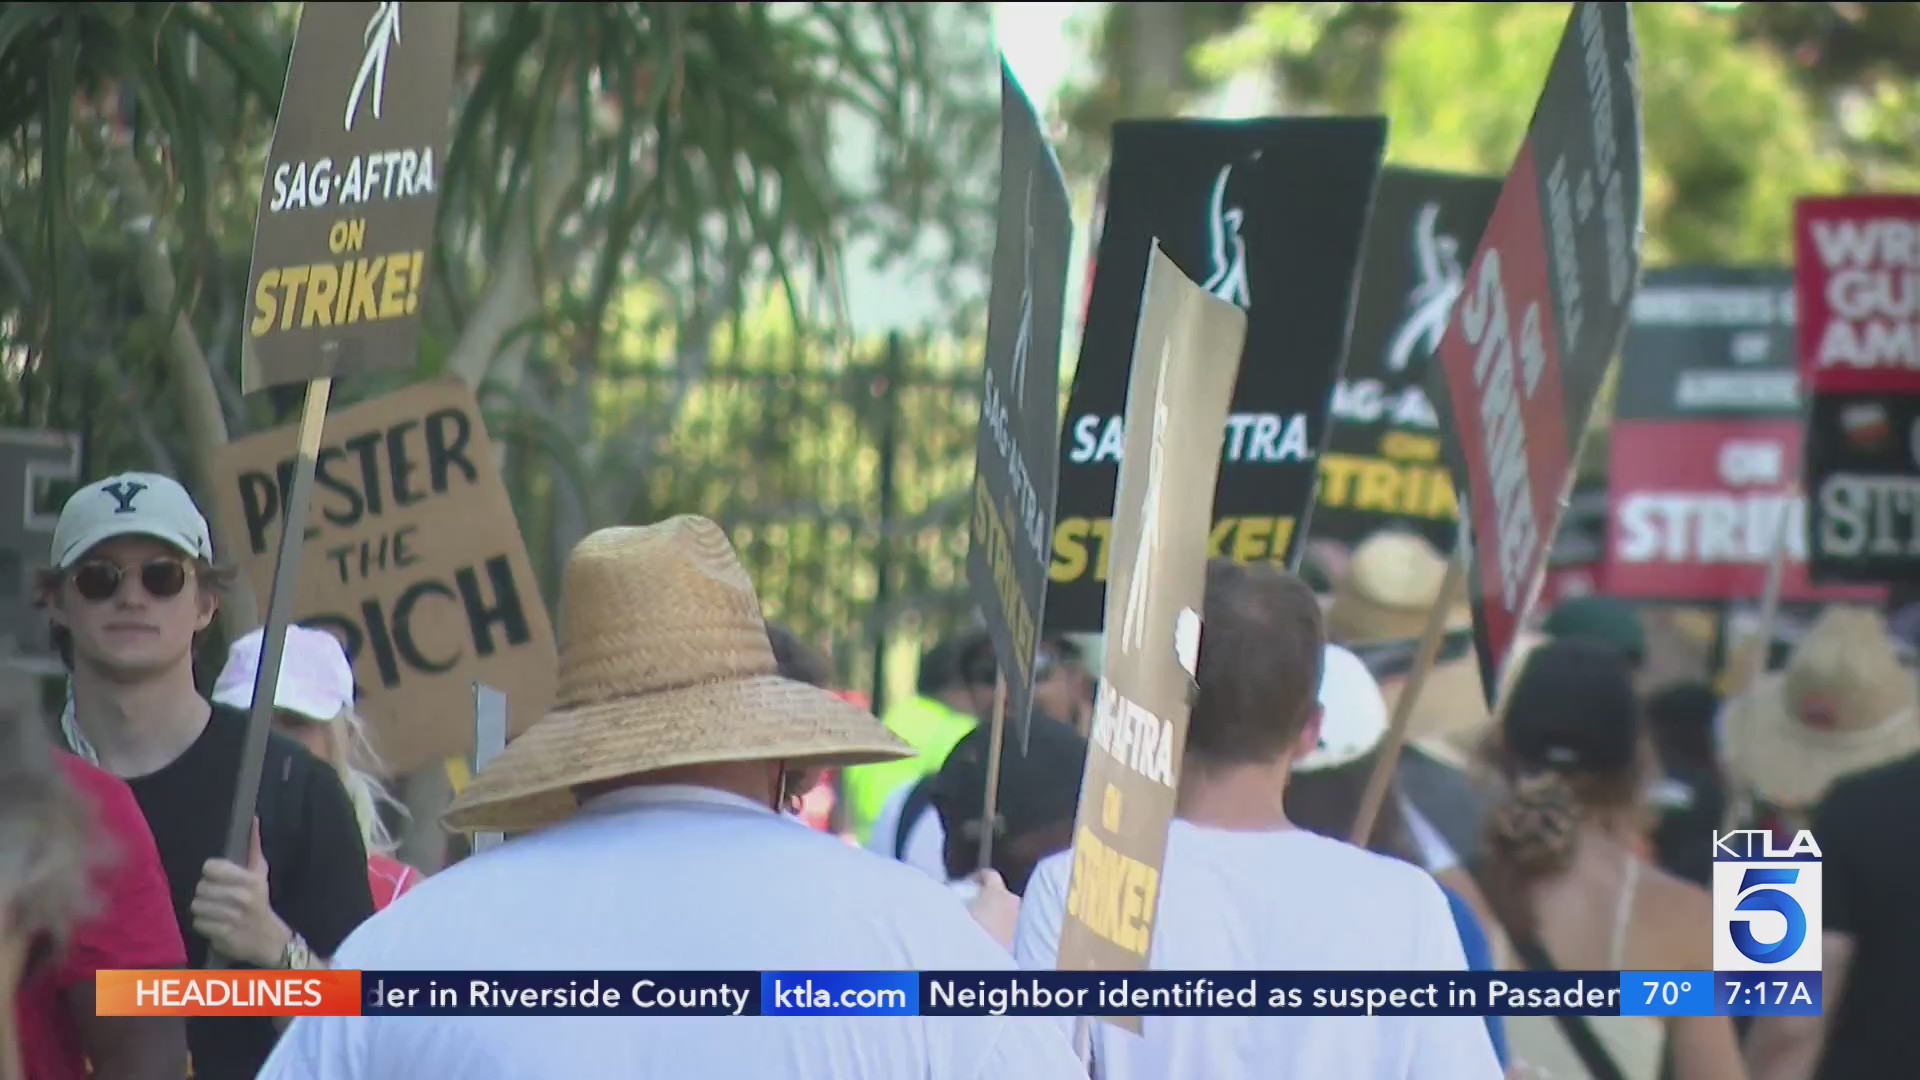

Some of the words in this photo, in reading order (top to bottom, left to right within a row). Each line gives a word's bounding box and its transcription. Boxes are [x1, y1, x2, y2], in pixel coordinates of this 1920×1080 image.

[328, 219, 366, 254] ON
[1808, 217, 1920, 269] WR
[250, 251, 424, 337] STRIKE!
[1825, 266, 1920, 323] GU
[1820, 318, 1920, 369] AM
[101, 481, 148, 513] Y
[327, 525, 423, 585] THE
